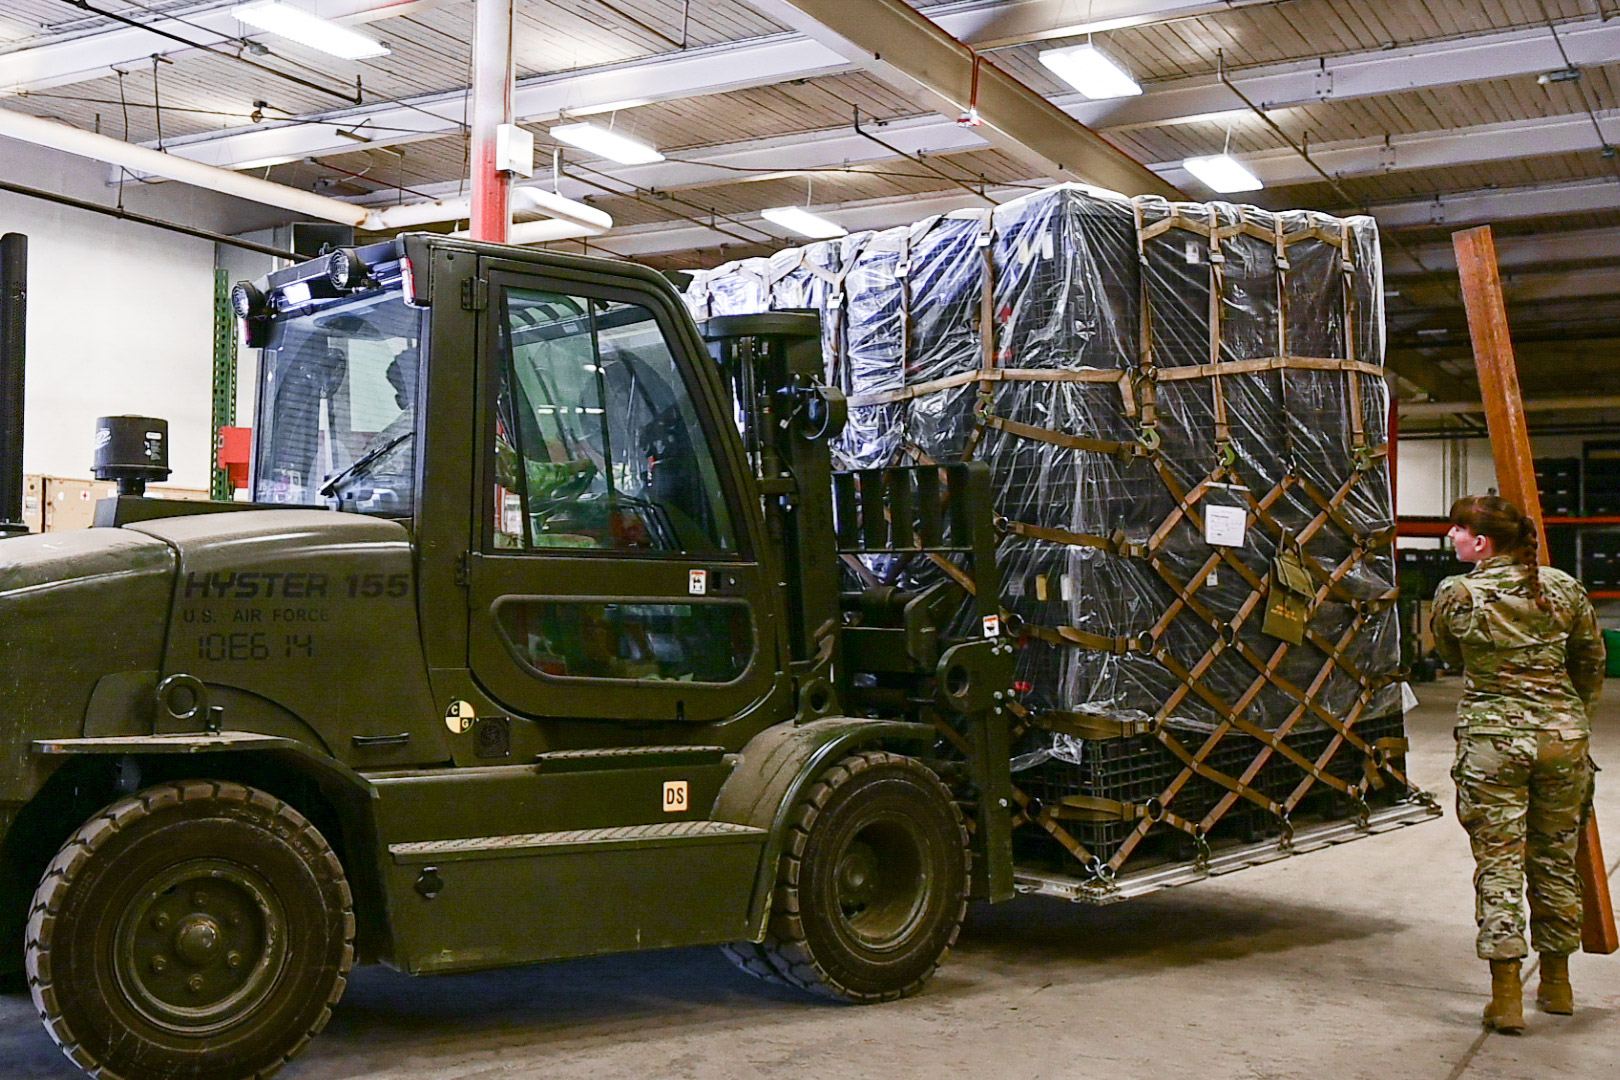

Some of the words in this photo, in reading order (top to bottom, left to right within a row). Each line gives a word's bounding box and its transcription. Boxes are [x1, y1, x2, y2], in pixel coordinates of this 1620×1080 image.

[184, 571, 329, 599] HYSTER
[347, 573, 409, 599] 155
[183, 609, 217, 623] U.S.
[232, 609, 262, 623] AIR
[272, 608, 329, 623] FORCE
[285, 633, 313, 659] 14
[450, 705, 459, 715] C
[461, 719, 470, 729] G
[666, 787, 684, 805] DS
